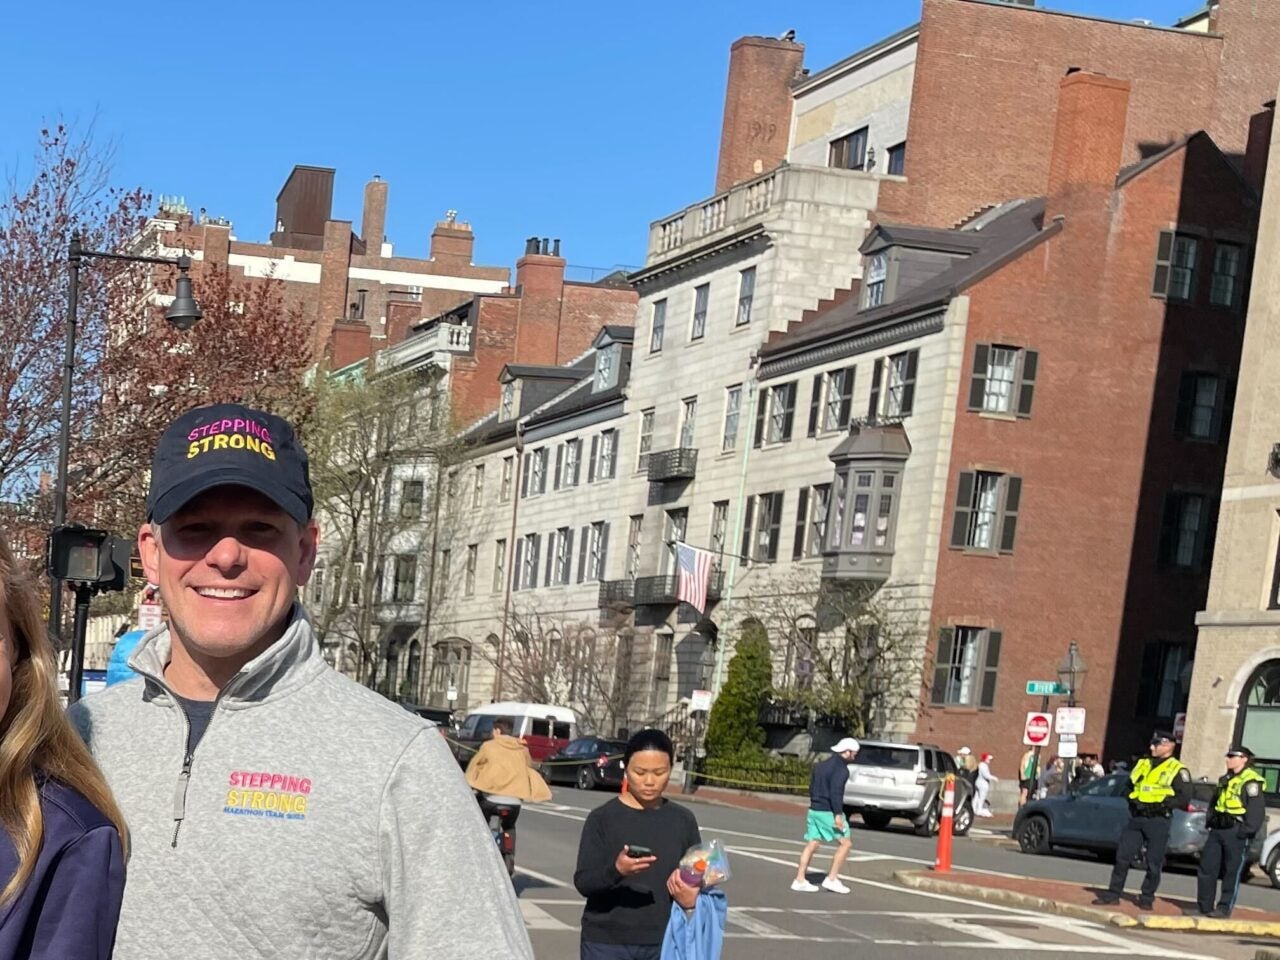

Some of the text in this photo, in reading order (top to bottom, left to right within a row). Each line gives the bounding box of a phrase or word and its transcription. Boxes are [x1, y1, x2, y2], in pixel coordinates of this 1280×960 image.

[187, 418, 273, 443] STEPPING
[186, 433, 277, 461] STRONG
[228, 771, 312, 794] STEPPING
[226, 789, 306, 812] STRONG
